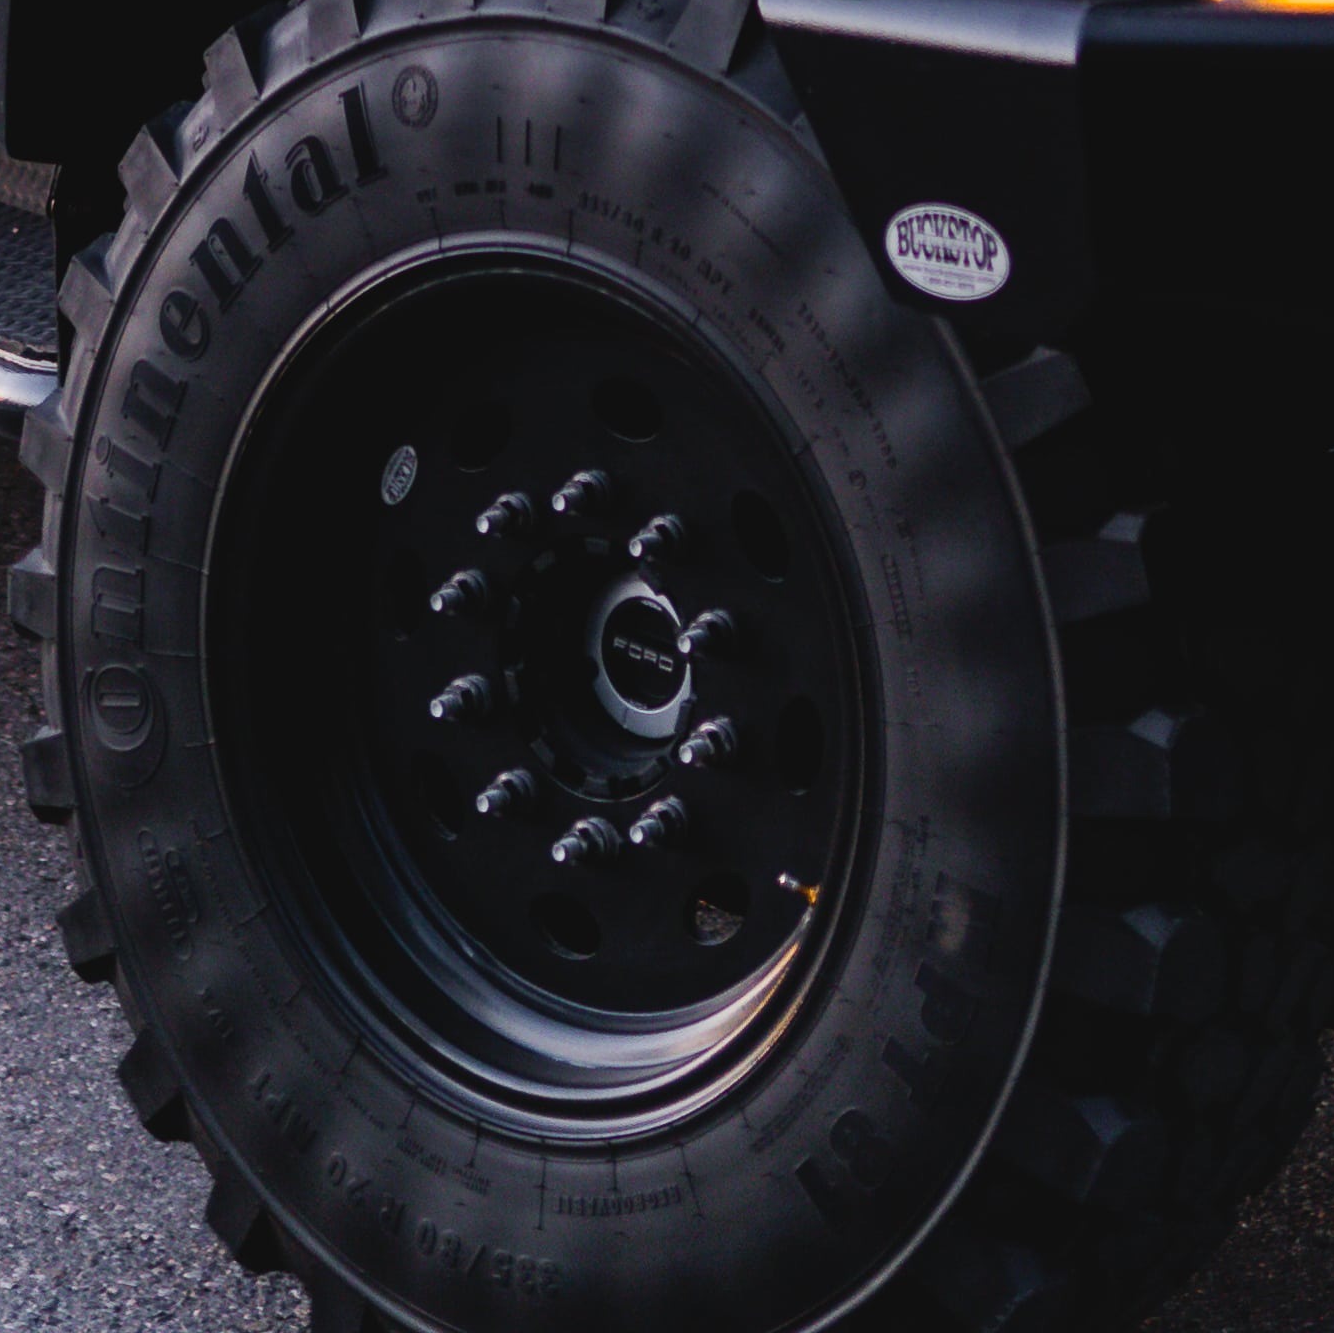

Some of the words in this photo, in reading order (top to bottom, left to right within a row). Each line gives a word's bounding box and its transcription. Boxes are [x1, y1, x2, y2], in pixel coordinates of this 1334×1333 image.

[896, 213, 998, 272] BUCKSTOP
[81, 81, 387, 788] Continental
[614, 637, 673, 672] FORD
